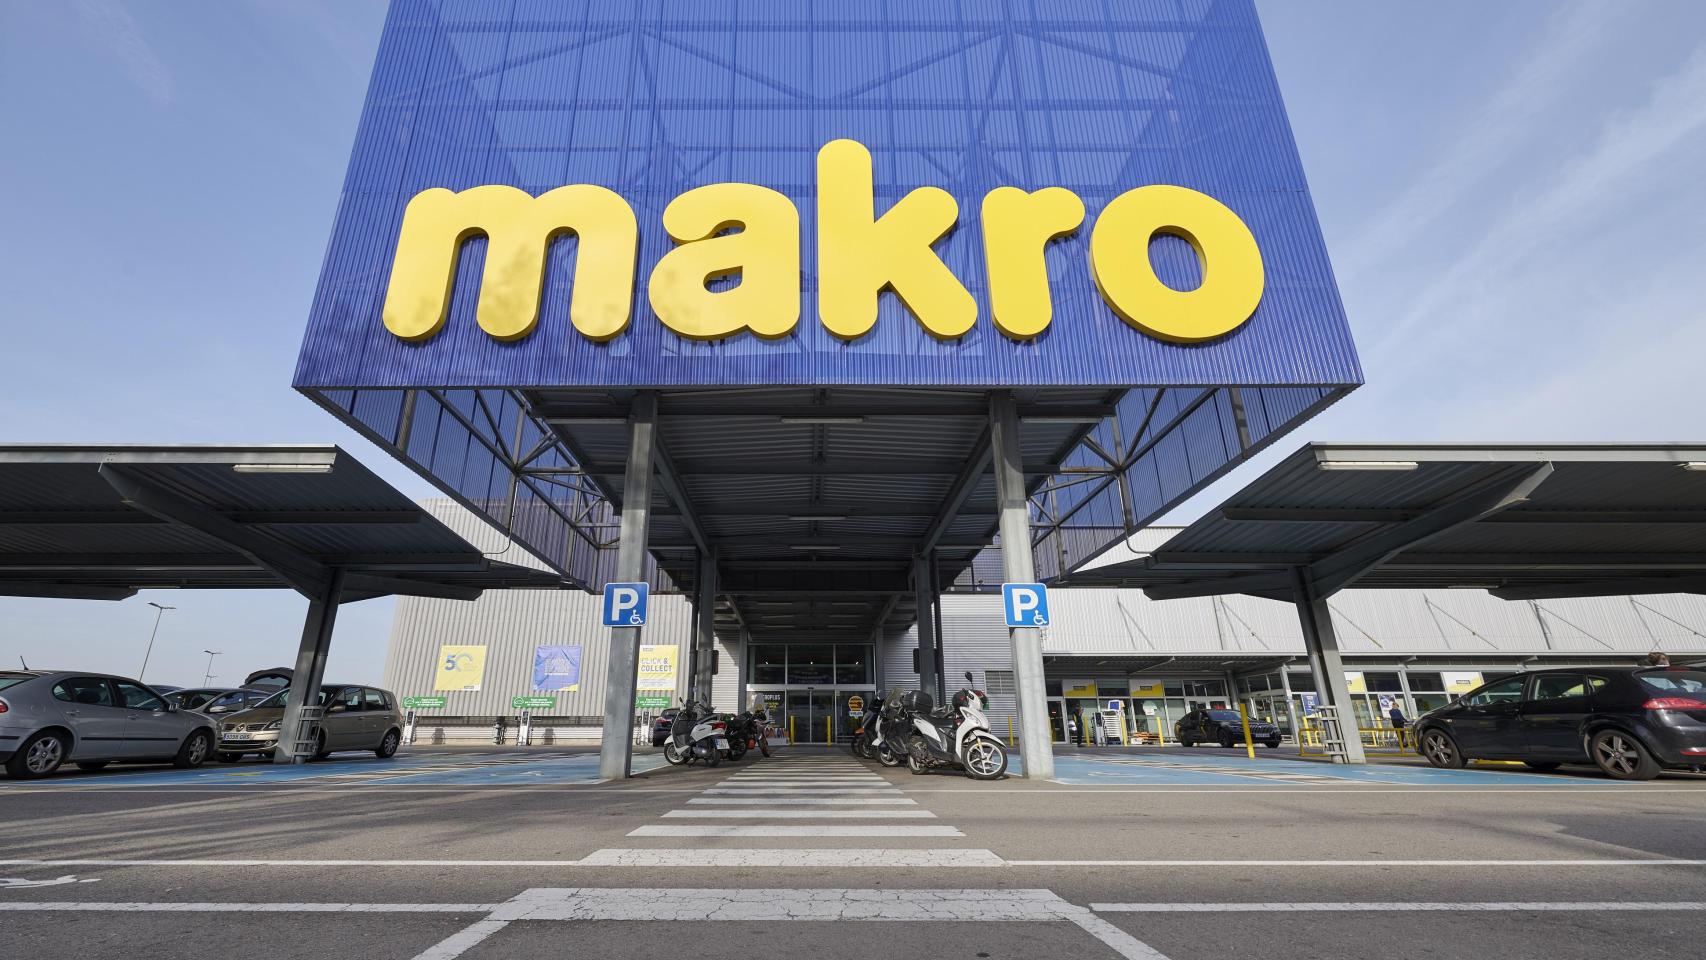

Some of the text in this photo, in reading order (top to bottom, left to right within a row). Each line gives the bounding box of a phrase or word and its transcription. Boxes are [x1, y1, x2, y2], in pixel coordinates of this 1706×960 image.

[382, 138, 1265, 344] makro
[612, 588, 638, 621] P
[1012, 588, 1038, 621] P
